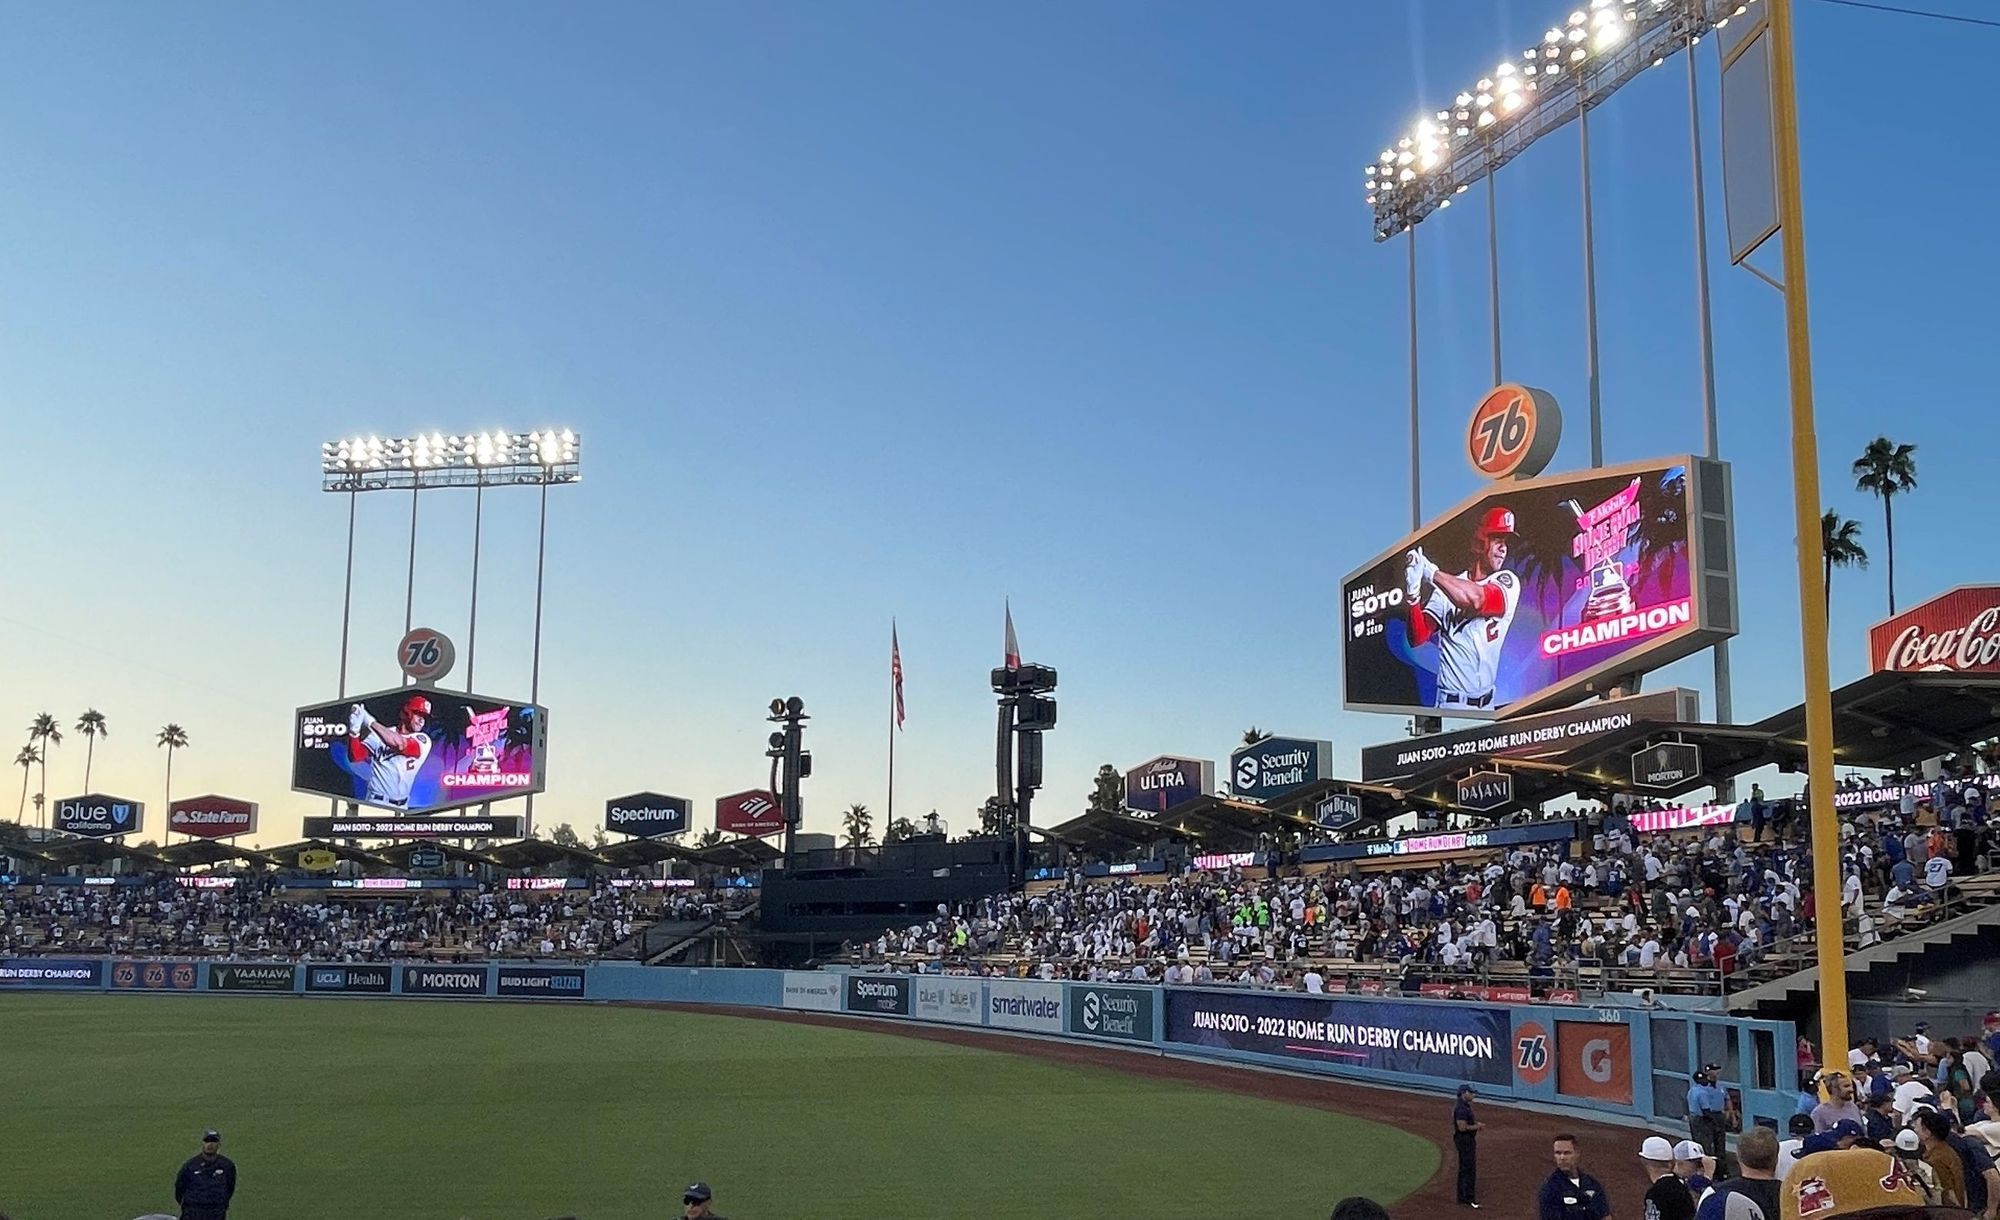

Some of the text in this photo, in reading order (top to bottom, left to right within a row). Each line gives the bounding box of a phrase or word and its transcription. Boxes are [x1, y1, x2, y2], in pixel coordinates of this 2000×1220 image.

[1475, 394, 1529, 466] 76
[1352, 584, 1374, 601] JUAN
[1352, 587, 1403, 618] SOTO
[1543, 602, 1690, 654] CHAMPION
[405, 637, 441, 667] 76
[303, 723, 347, 736] SOTO
[1397, 751, 1421, 766] JUAN
[1421, 746, 1447, 761] SOTO
[1453, 742, 1477, 756] 2022
[1478, 736, 1508, 752] HOME
[1509, 732, 1532, 747] RUN
[1533, 726, 1566, 743] DERBY
[1566, 713, 1632, 738] CHAMPION
[1261, 748, 1310, 770] Security
[442, 772, 530, 786] CHAMPION
[1140, 771, 1185, 790] ULTRA
[1262, 766, 1303, 788] Benefit
[1647, 769, 1683, 783] MORTON
[1461, 781, 1508, 801] DASANI
[1834, 793, 1862, 807] 2022
[1864, 787, 1900, 804] HOME
[60, 801, 108, 821] blue
[610, 806, 676, 824] Spectrum
[66, 820, 112, 831] california
[332, 823, 352, 832] JUAN
[352, 823, 371, 832] SOTO
[394, 823, 415, 832] HOME
[416, 823, 432, 832] RUN
[432, 823, 454, 832] DERBY
[454, 823, 493, 832] CHAMPION
[1409, 838, 1428, 851] HOME
[1428, 836, 1443, 849] RUN
[1443, 834, 1466, 848] DERBY
[1466, 834, 1488, 846] 2022
[18, 969, 44, 978] DERBY
[44, 969, 91, 979] CHAMPION
[119, 969, 134, 980] 76
[148, 969, 163, 980] 76
[176, 969, 192, 981] 76
[316, 973, 384, 986] UCLA Health
[422, 974, 480, 988] MORTON
[501, 976, 521, 986] BUD
[522, 977, 550, 987] LIGHT
[856, 979, 898, 998] Spectrum
[992, 996, 1060, 1019] smartwater
[1102, 993, 1138, 1018] Security
[1599, 1008, 1620, 1022] 360
[1102, 1014, 1134, 1034] Benefit
[1193, 1011, 1219, 1030] JUAN
[1220, 1014, 1249, 1033] SOTO
[1256, 1016, 1285, 1037] 2022
[1288, 1020, 1324, 1042] HOME
[1327, 1023, 1355, 1044] RUN
[1358, 1026, 1401, 1050] DERBY
[1402, 1030, 1493, 1060] CHAMPION
[1518, 1034, 1548, 1072] 76
[1582, 1038, 1612, 1083] G
